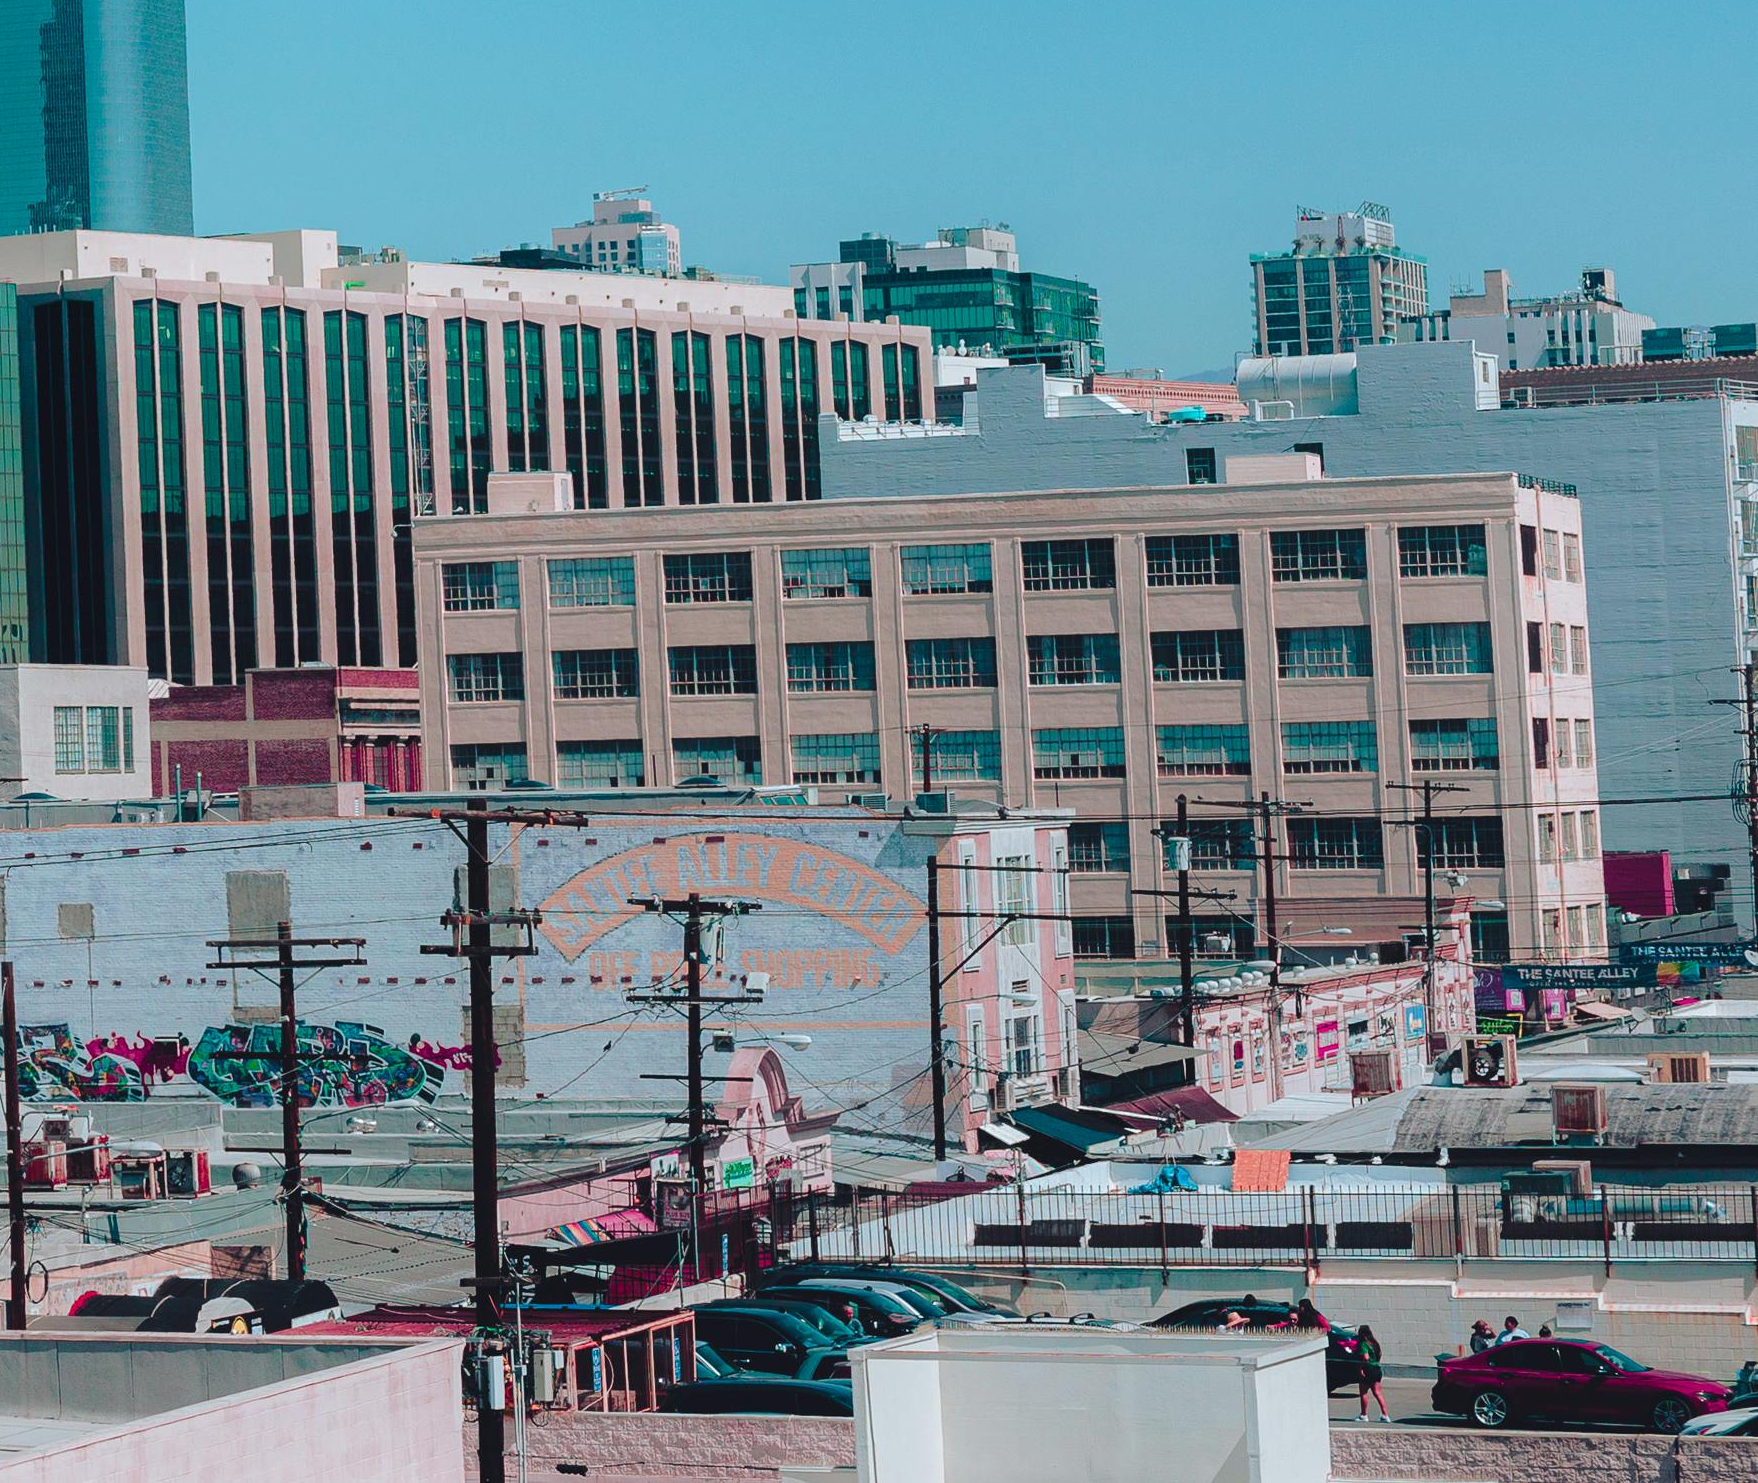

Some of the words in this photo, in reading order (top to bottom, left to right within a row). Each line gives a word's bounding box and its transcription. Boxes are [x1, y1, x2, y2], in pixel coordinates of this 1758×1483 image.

[545, 854, 661, 946] SANTEE
[675, 842, 780, 890] ALLEY
[789, 850, 915, 945] CENTER
[1517, 968, 1543, 981] THE
[1545, 968, 1595, 981] SANTEE
[1597, 966, 1639, 979] ALLEY
